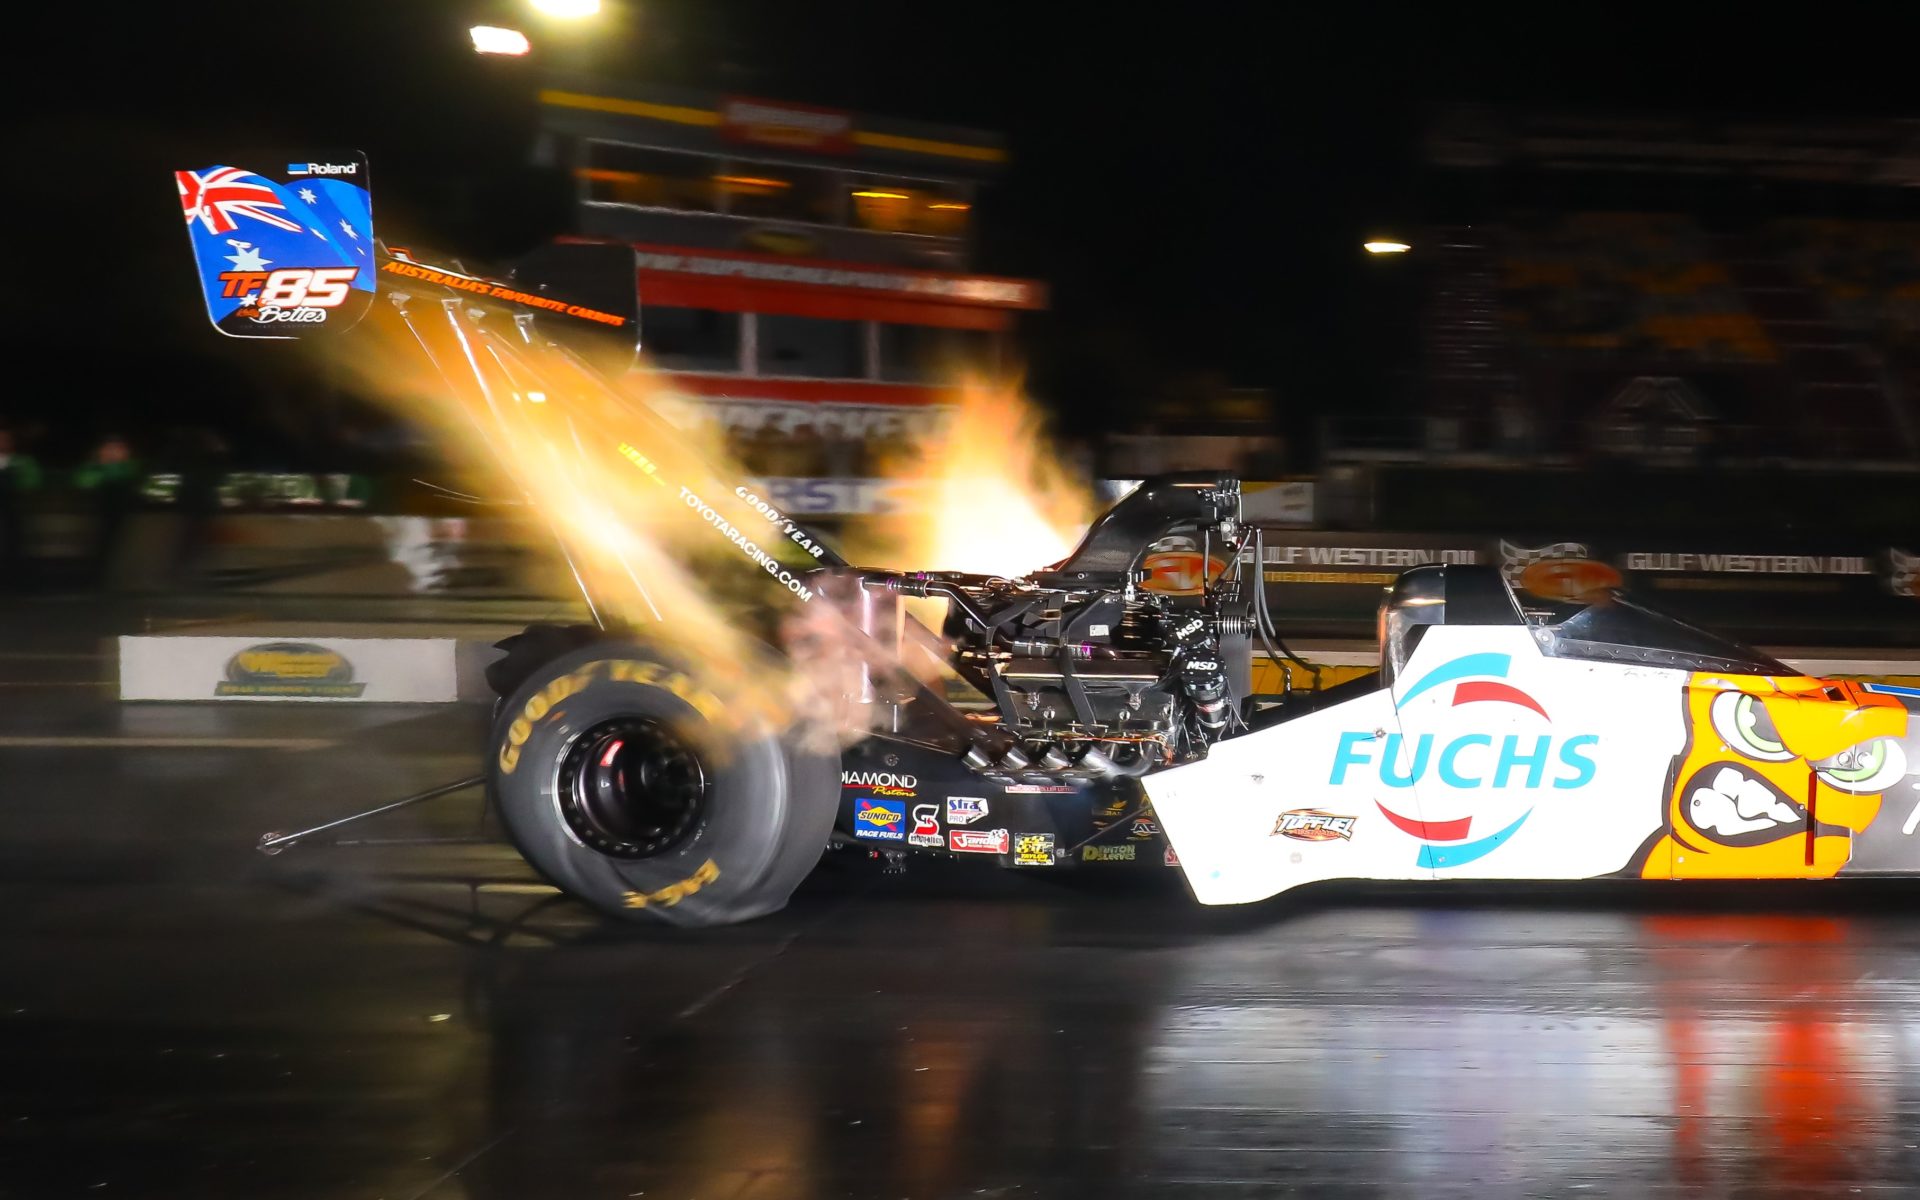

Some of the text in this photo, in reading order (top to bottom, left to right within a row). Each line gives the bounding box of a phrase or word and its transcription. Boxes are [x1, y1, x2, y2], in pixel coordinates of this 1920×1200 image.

[307, 162, 356, 175] Roland
[218, 268, 358, 308] TF 85
[381, 261, 493, 294] AUSTRALIA'S
[735, 485, 824, 559] GOODYEAR
[679, 485, 813, 603] TOYOTARACING.COM
[1308, 547, 1435, 567] WESTERN
[1627, 553, 1872, 575] GULF WESTERN OIL
[1176, 619, 1204, 640] MSD
[1186, 660, 1218, 671] MSD
[1328, 731, 1600, 790] FUCHS
[871, 785, 918, 797] Pistons
[859, 811, 901, 822] SUNOCO
[855, 830, 904, 840] RACE FUELS
